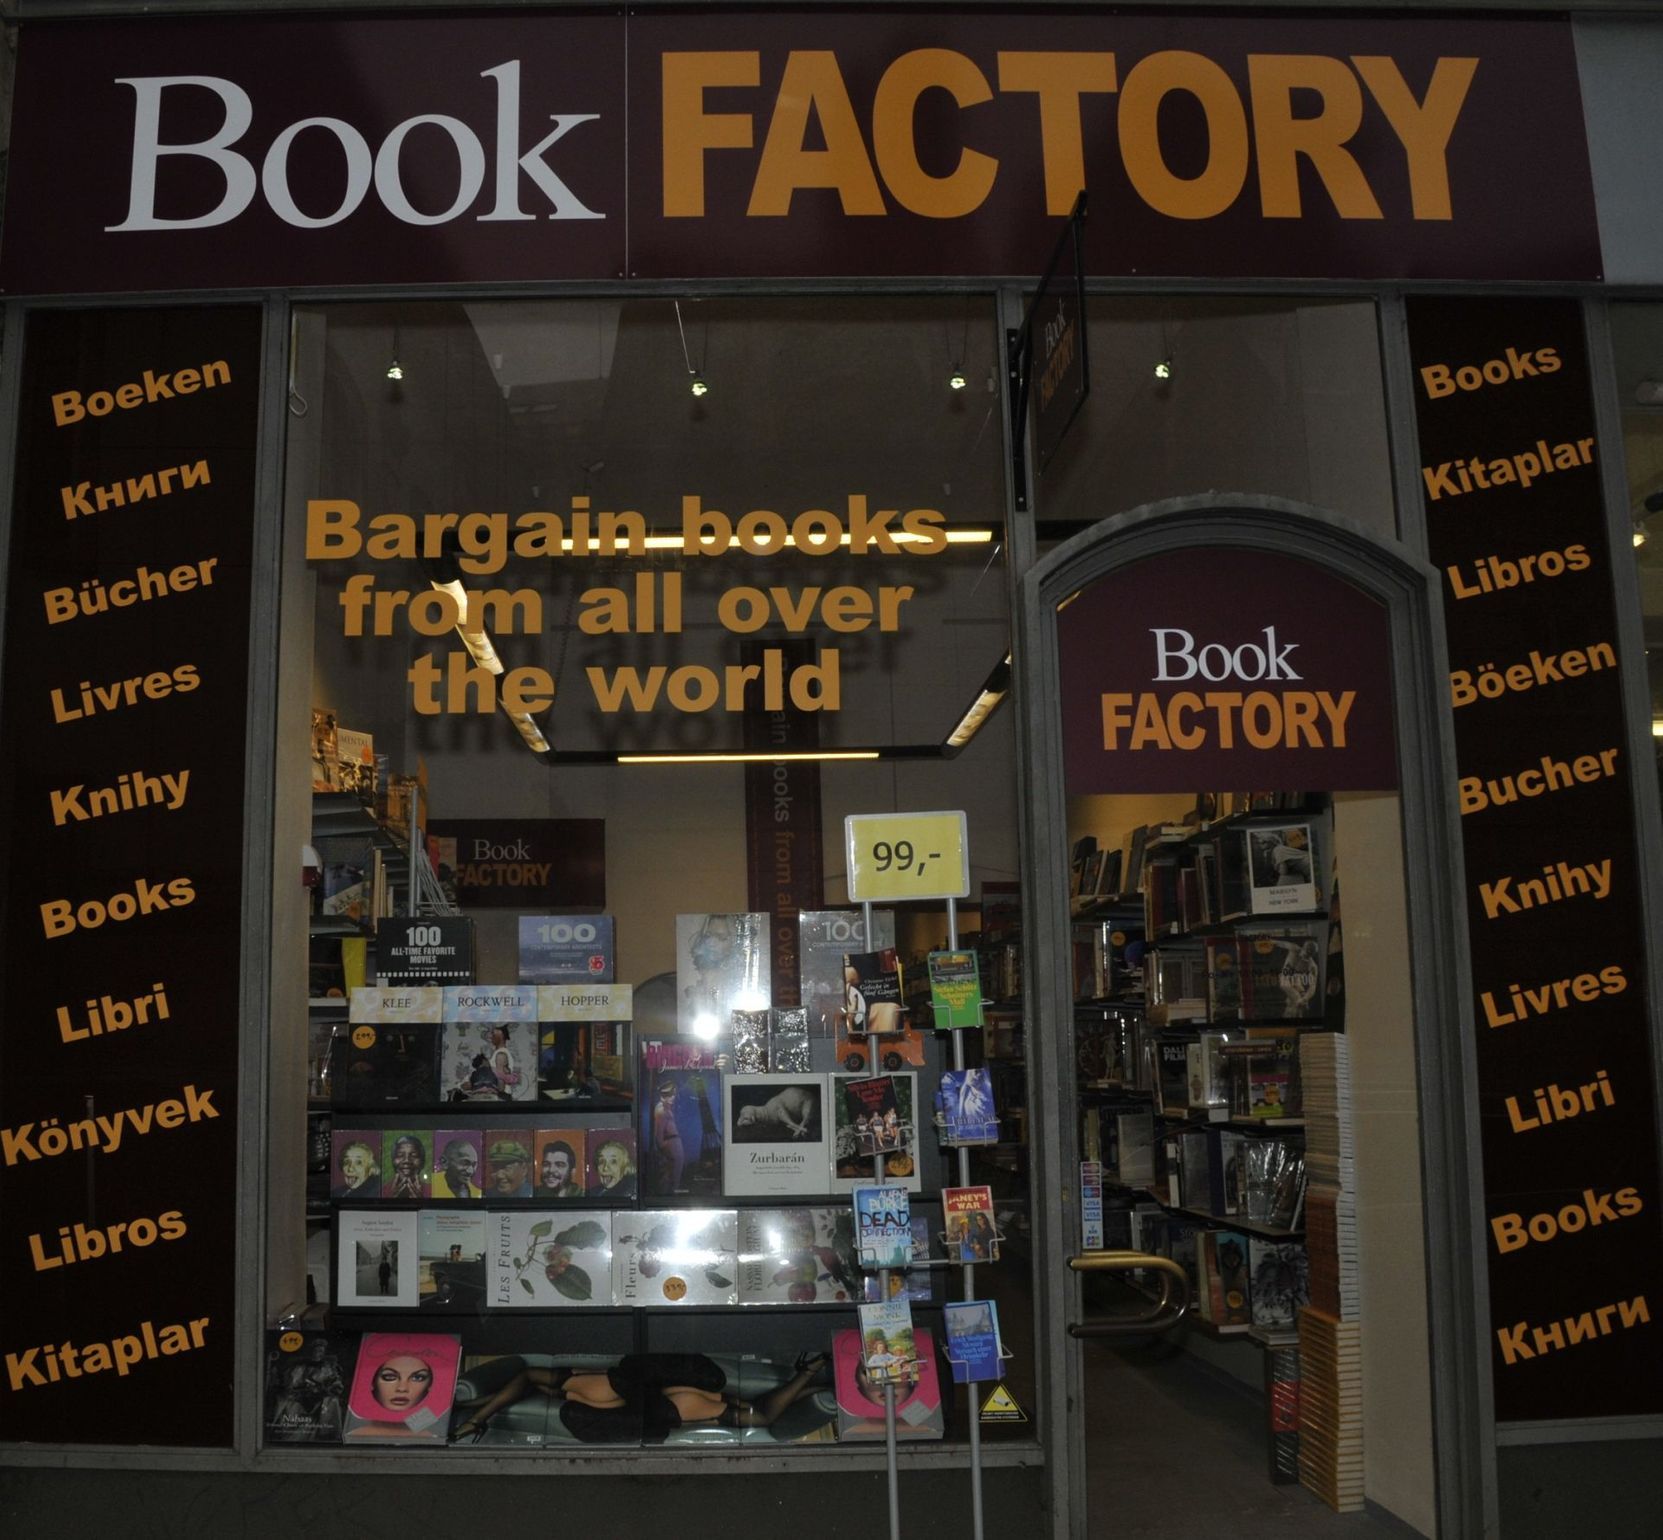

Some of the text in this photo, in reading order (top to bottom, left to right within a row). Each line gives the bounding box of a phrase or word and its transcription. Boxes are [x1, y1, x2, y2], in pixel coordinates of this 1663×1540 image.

[105, 49, 1478, 231] Book FACTORY
[1045, 296, 1066, 360] Book
[53, 361, 230, 425] Boeken
[1422, 346, 1561, 400] Books
[62, 461, 210, 519] Книги
[1424, 439, 1594, 500] Kitaplar
[306, 495, 948, 574] Bargain books
[44, 559, 217, 624] Bücher
[1448, 545, 1590, 599] Libros
[339, 572, 914, 636] from all over
[408, 651, 555, 715] the
[586, 649, 840, 712] world
[1150, 626, 1302, 681] Book
[1451, 642, 1616, 708] Böeken
[52, 665, 200, 722] Livres
[1102, 691, 1355, 750] FACTORY
[51, 771, 188, 825] Knihy
[1459, 749, 1617, 815] Bucher
[456, 863, 552, 886] FACTORY
[473, 838, 531, 861] Book
[775, 832, 796, 885] from
[873, 841, 941, 876] 99,-
[41, 879, 195, 938] Books
[776, 893, 796, 919] all
[1480, 860, 1611, 918] Knihy
[391, 947, 456, 956] ALL-TIME FAVORITE
[406, 926, 442, 947] 100
[409, 955, 437, 964] MOVIES
[537, 923, 596, 943] 100
[777, 927, 794, 972] over
[57, 983, 169, 1042] Libri
[382, 998, 411, 1009] KLEE
[457, 997, 525, 1007] ROCKWELL
[561, 995, 609, 1006] HOPPER
[1482, 967, 1626, 1029] Livres
[1, 1086, 219, 1165] Könyvek
[1507, 1071, 1614, 1132] Libri
[750, 1152, 805, 1163] Zurbarán
[859, 1211, 910, 1228] DEAD
[948, 1193, 988, 1204] JANEY'S
[957, 1202, 980, 1210] WAR
[1492, 1186, 1642, 1253] Books
[30, 1211, 186, 1270] Libros
[498, 1215, 511, 1304] LES FRUITS
[625, 1252, 636, 1298] Fleurs
[7, 1318, 208, 1389] Kitaplar
[1499, 1296, 1650, 1364] Книги
